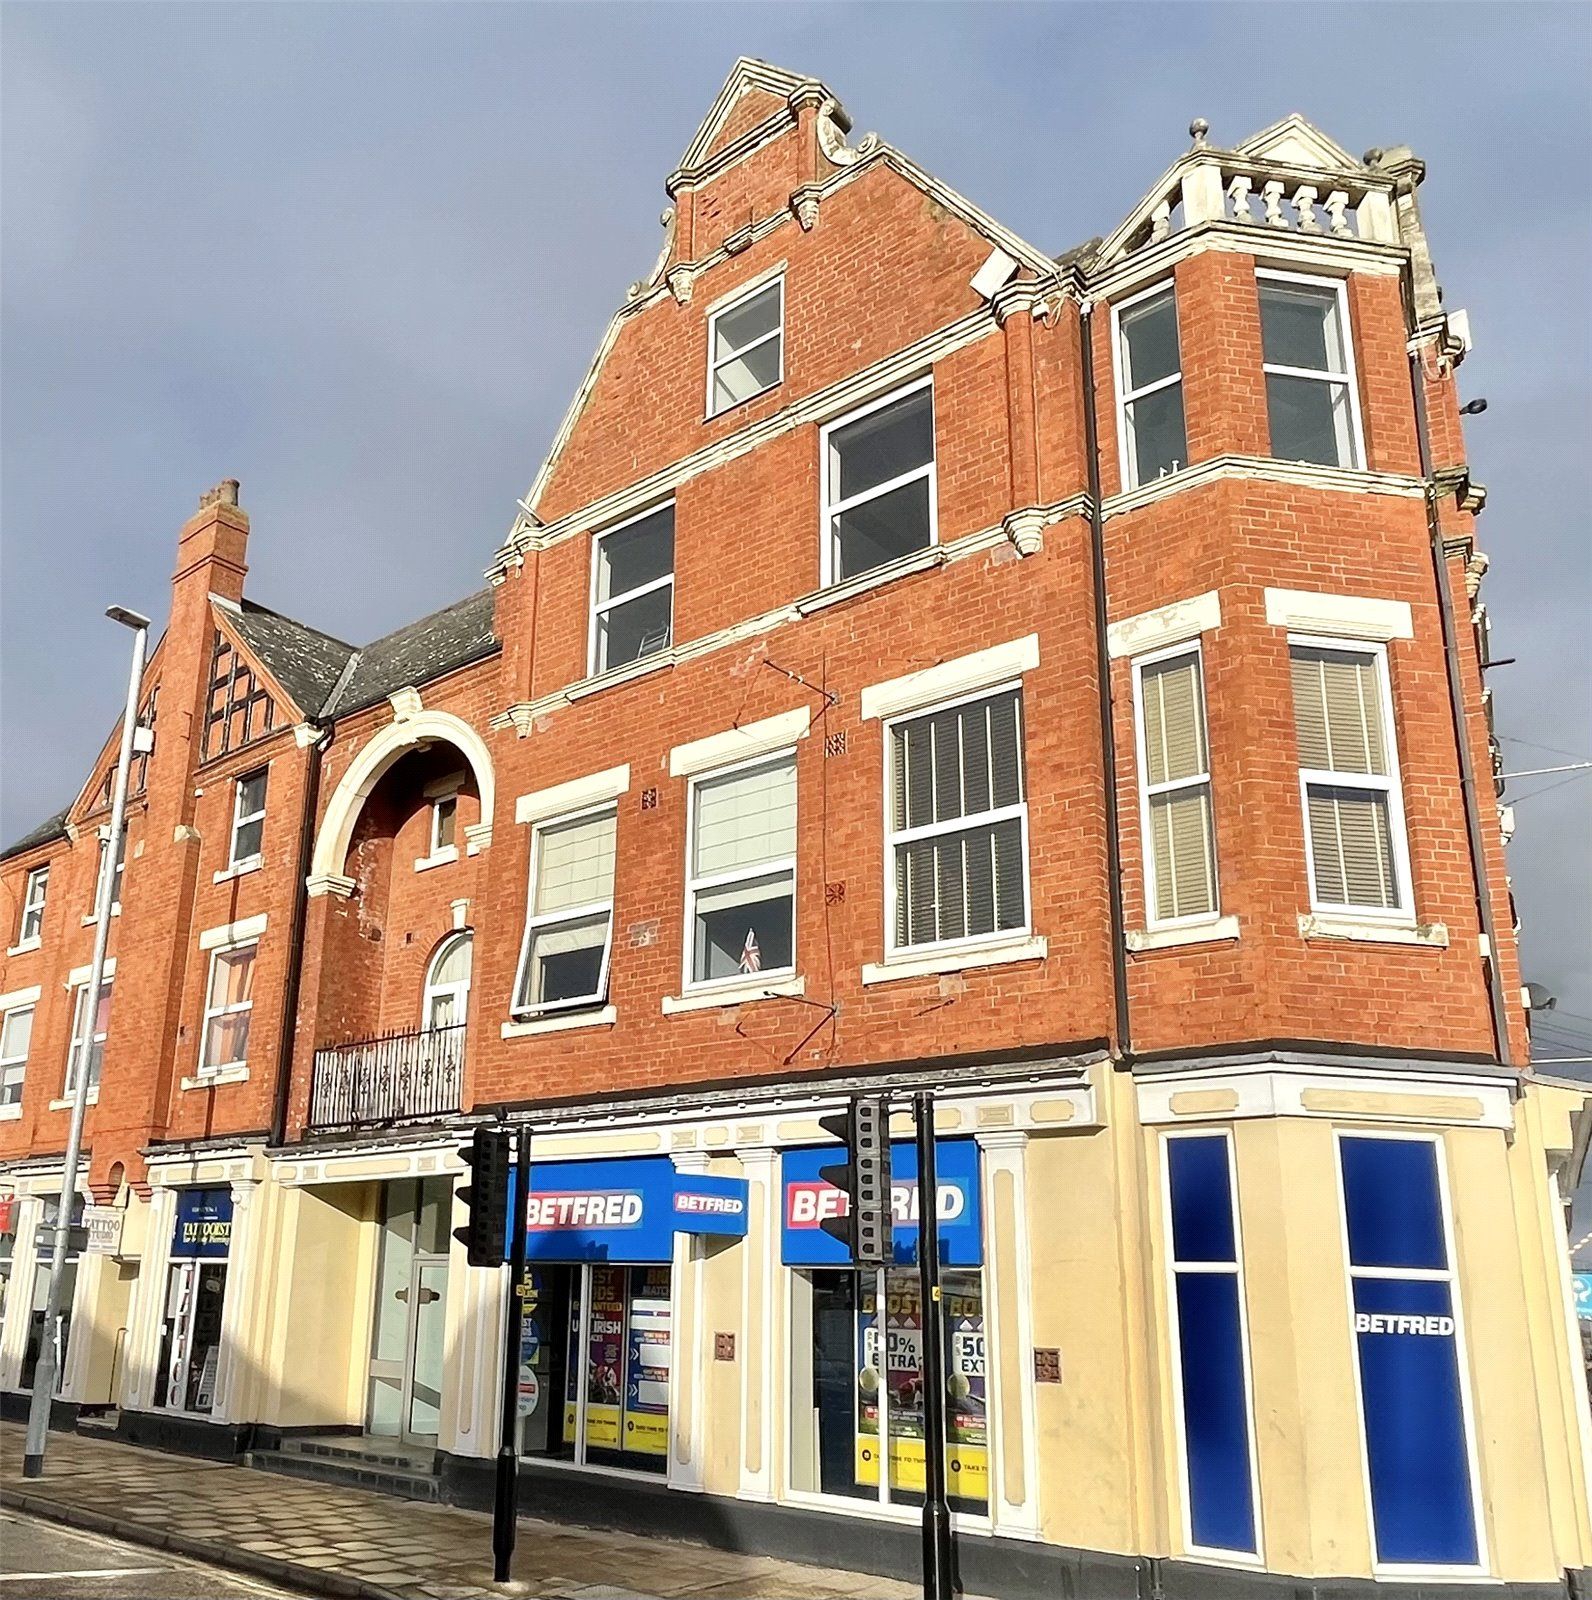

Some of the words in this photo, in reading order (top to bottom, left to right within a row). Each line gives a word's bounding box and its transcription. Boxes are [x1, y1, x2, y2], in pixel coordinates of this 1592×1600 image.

[527, 1194, 643, 1225] BETFRED
[677, 1195, 743, 1214] BETFRED
[791, 1185, 965, 1222] BERD
[83, 1218, 121, 1231] TATTOO
[861, 1294, 921, 1315] BOST
[594, 1320, 622, 1335] IRISH
[1355, 1313, 1455, 1336] BETFRED
[962, 1336, 985, 1357] 50
[872, 1353, 918, 1368] ETRA
[961, 1359, 985, 1373] EXT
